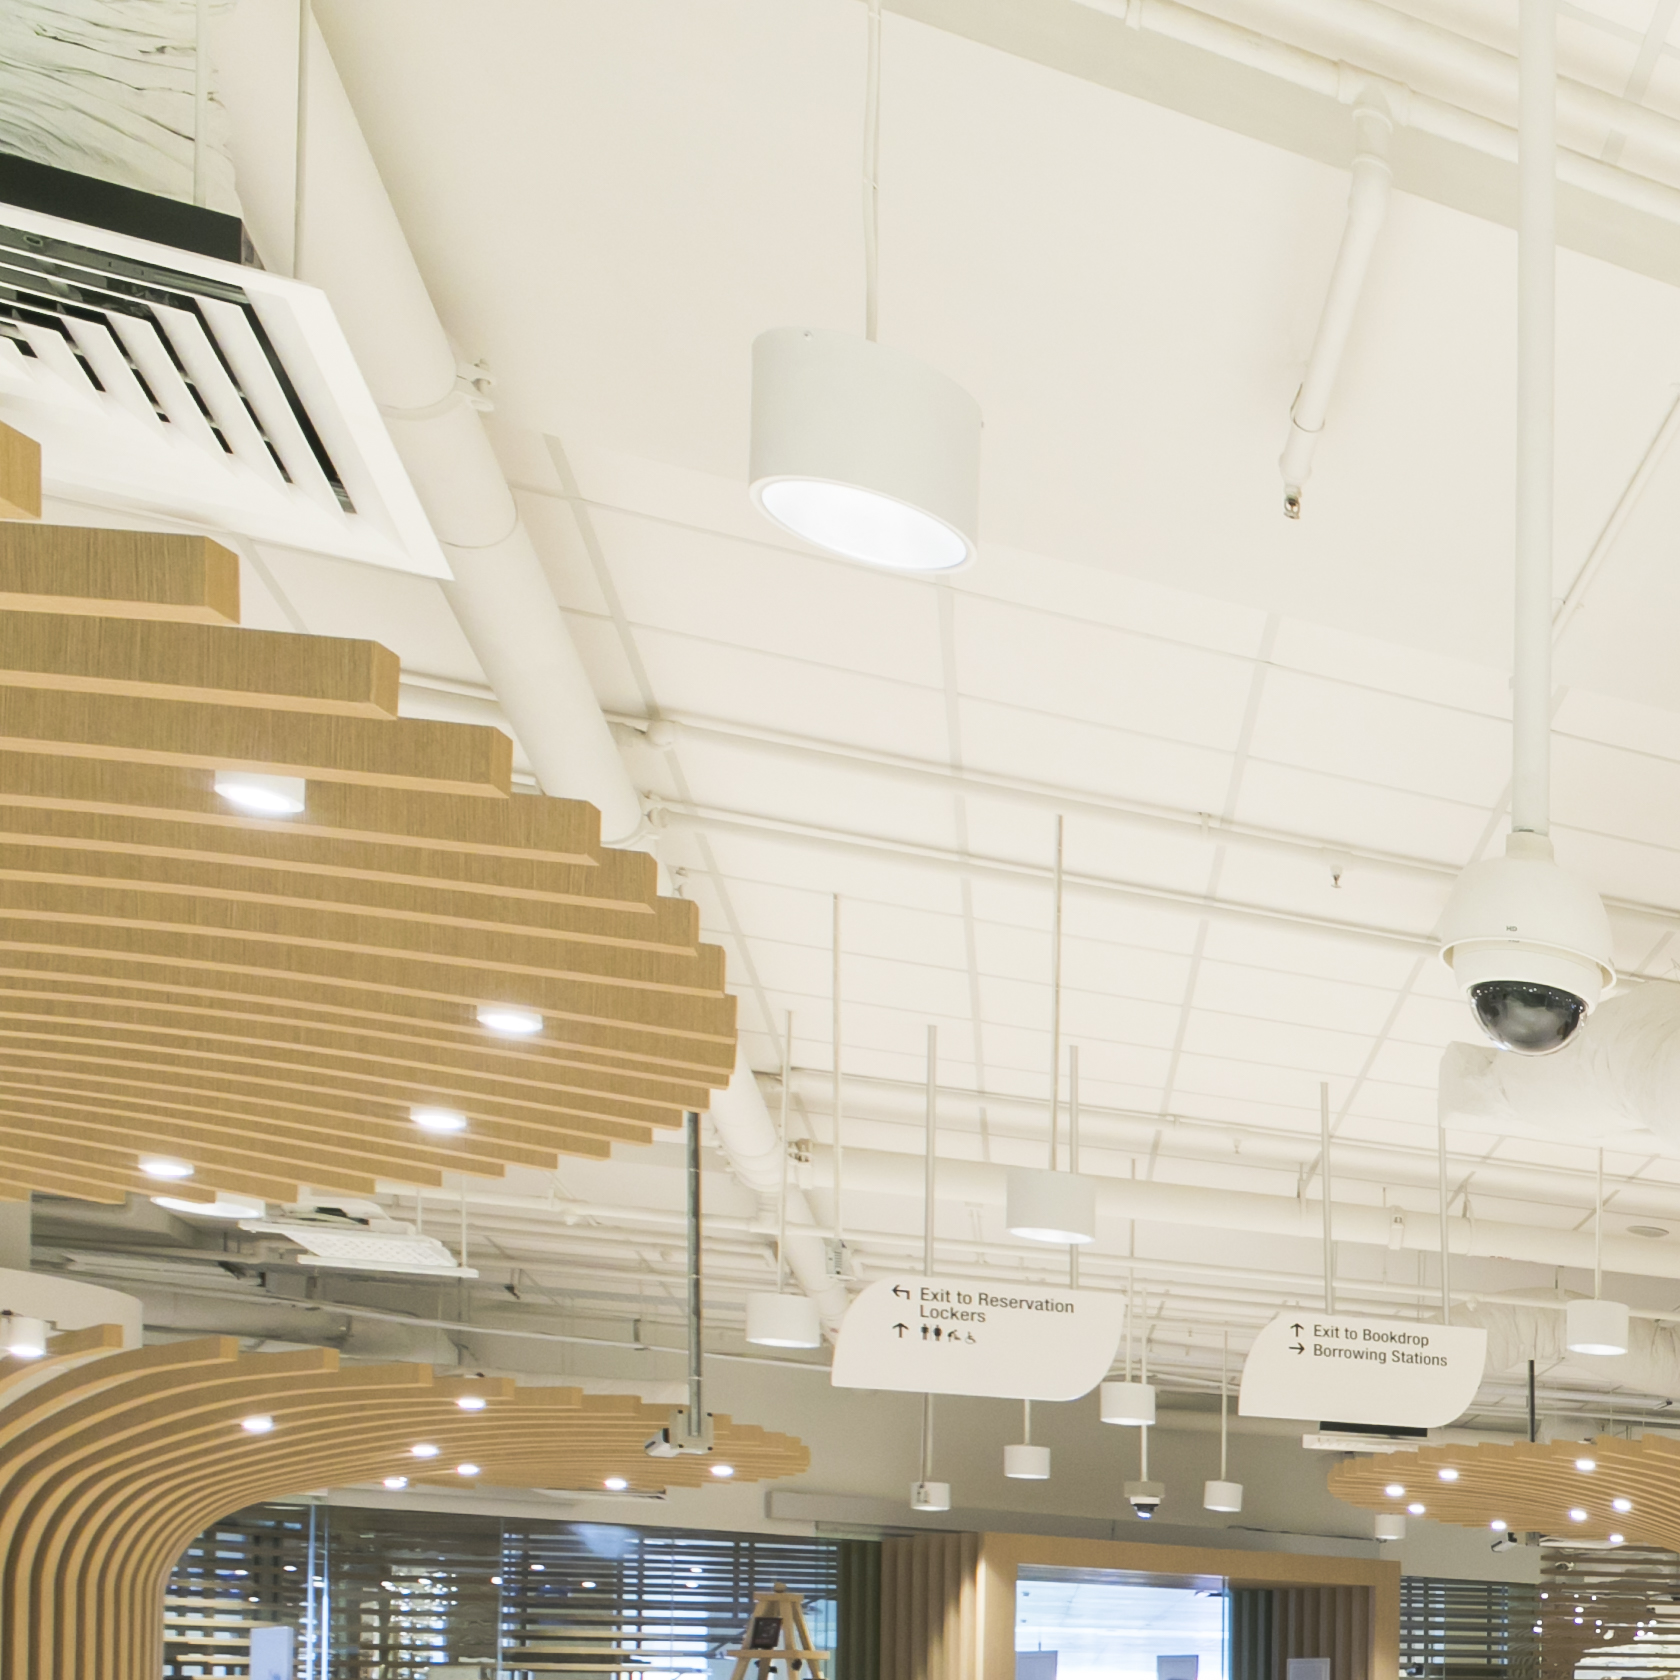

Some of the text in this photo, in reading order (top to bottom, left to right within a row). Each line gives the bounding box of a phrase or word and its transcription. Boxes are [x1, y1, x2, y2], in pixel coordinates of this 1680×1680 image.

[920, 1287, 1075, 1313] Exit to Reservation
[920, 1304, 986, 1323] Lockers
[1313, 1324, 1429, 1348] Exit to Bookdrop
[1313, 1344, 1448, 1367] Borrowing Stations
